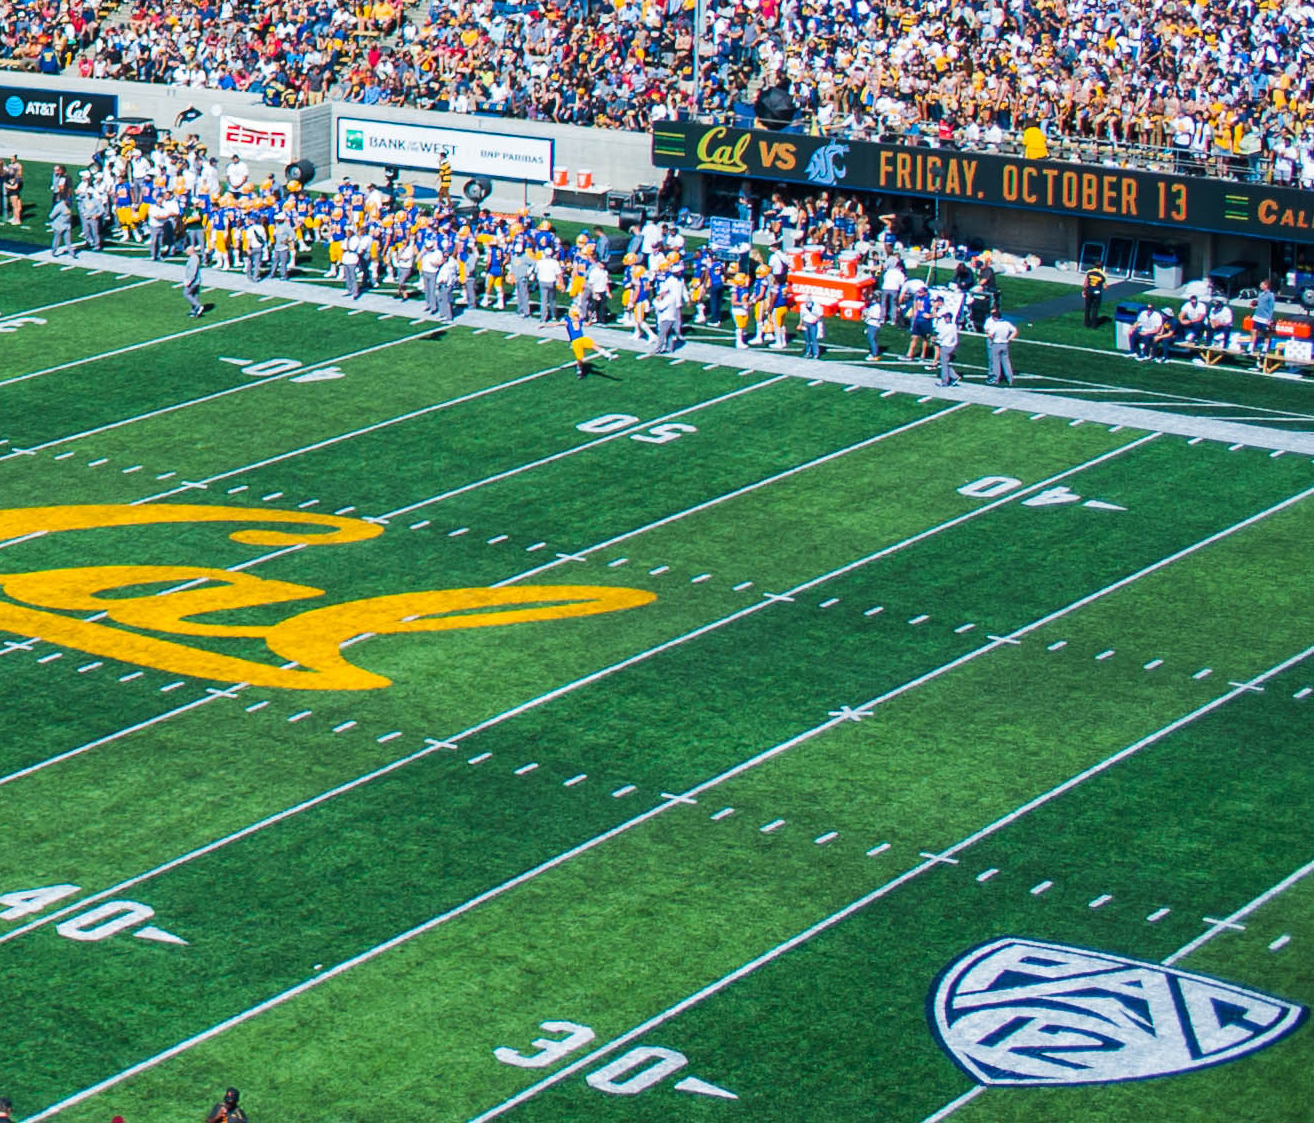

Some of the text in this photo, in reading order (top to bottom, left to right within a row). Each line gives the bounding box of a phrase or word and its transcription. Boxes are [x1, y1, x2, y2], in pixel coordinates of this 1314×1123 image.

[25, 101, 93, 124] AT&T Cal
[225, 124, 286, 148] ESPN
[369, 136, 407, 151] BANK
[418, 140, 457, 156] WEST
[696, 125, 797, 173] Cal VS
[1002, 164, 1138, 216] OCTOBER
[1157, 181, 1188, 221] 13
[955, 954, 1287, 1060] PAC
[493, 1019, 689, 1095] 30
